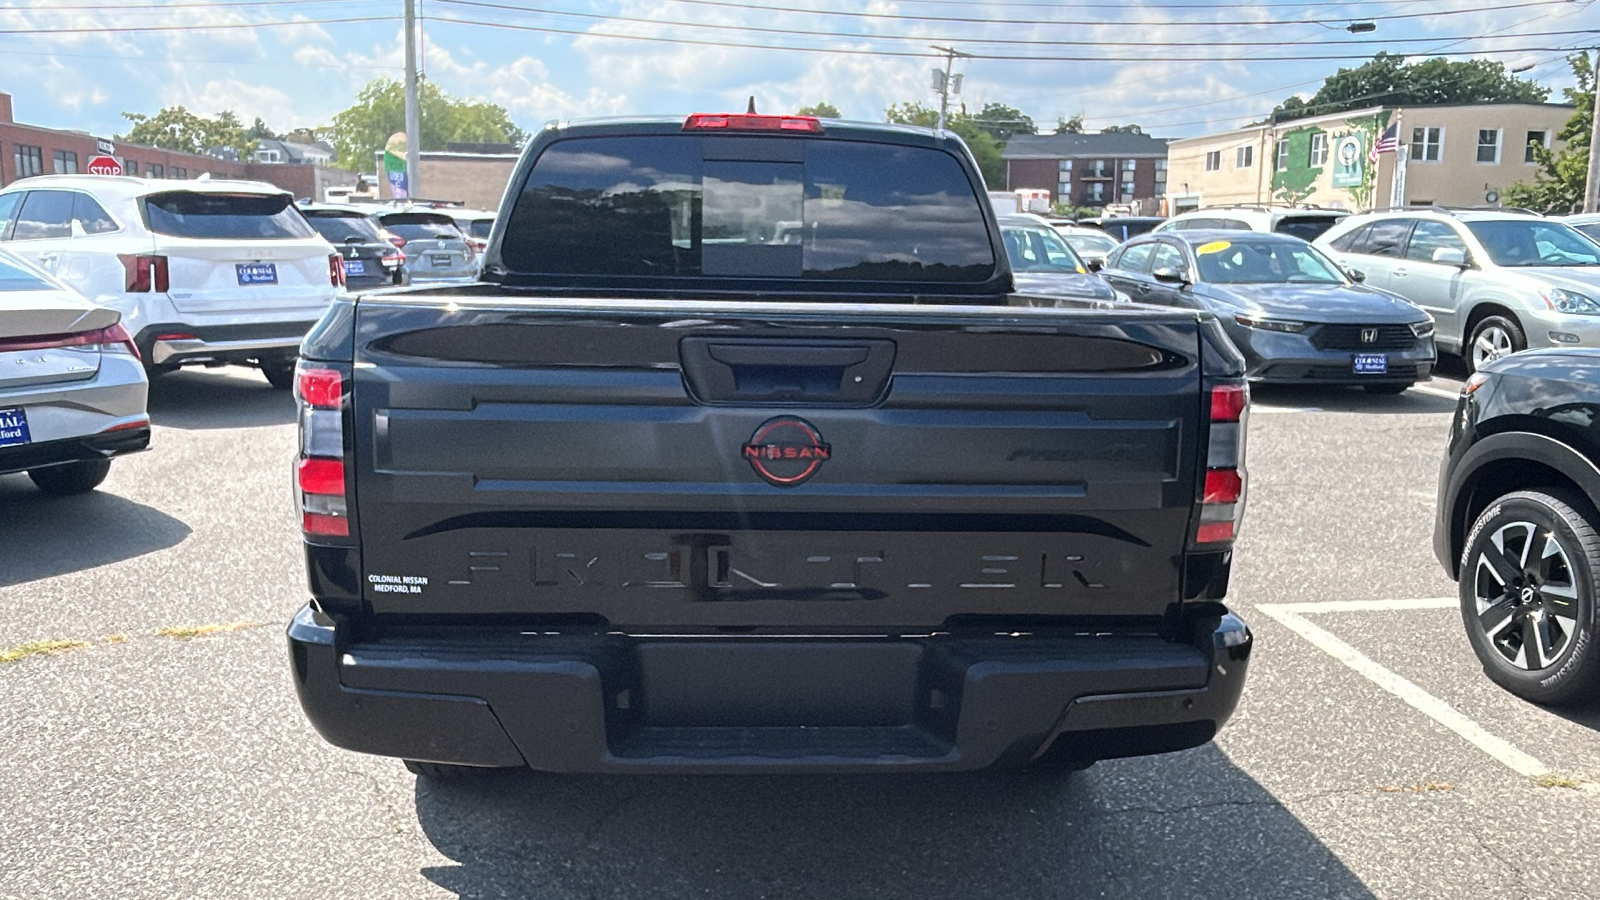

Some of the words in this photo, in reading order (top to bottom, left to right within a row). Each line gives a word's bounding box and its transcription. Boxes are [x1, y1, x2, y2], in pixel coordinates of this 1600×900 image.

[90, 166, 120, 175] STOP
[745, 446, 828, 459] NISSAN
[1461, 503, 1502, 568] BRIDGESTONE
[368, 574, 402, 584] COLONIAL
[402, 576, 428, 585] NISSAN
[374, 584, 409, 594] MEDFORD,
[410, 585, 422, 594] MA
